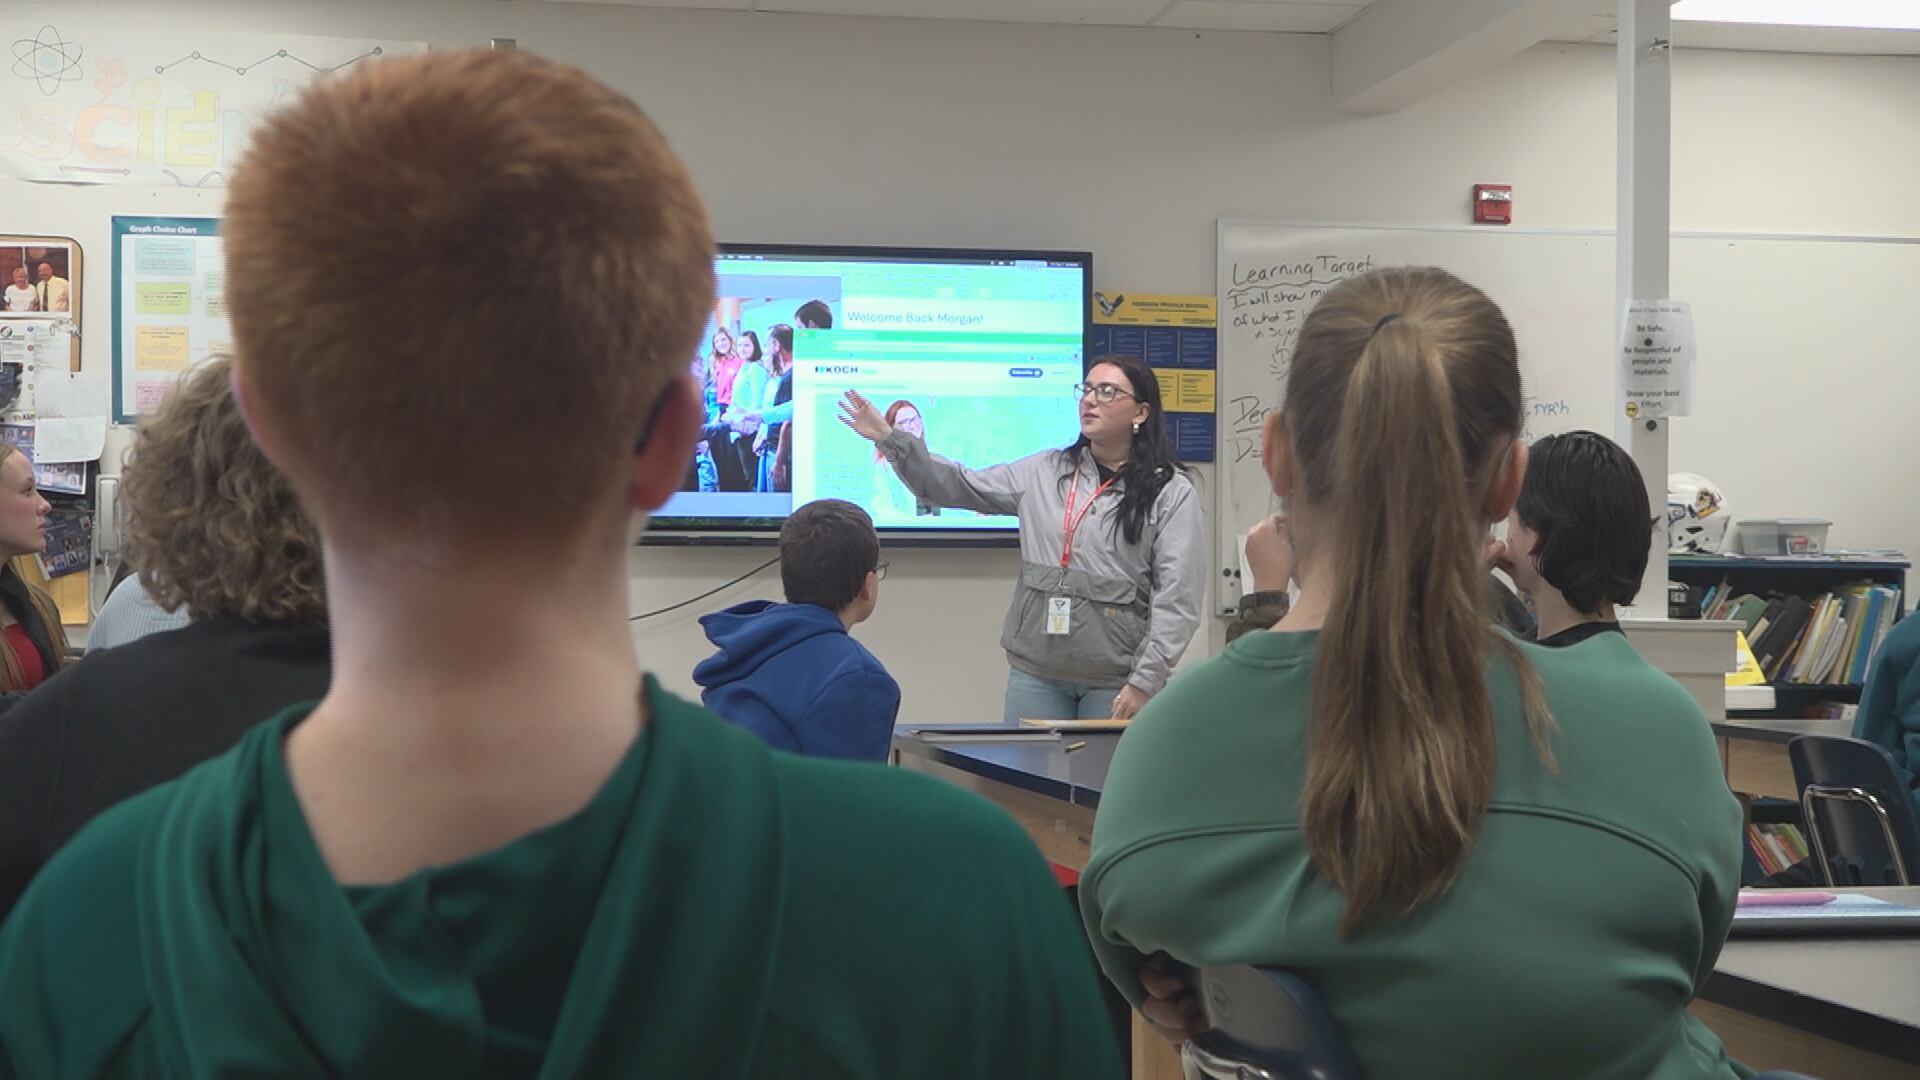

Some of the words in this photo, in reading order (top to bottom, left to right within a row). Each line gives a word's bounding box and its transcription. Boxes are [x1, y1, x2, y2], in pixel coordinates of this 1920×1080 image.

[129, 225, 152, 233] Graph
[152, 225, 176, 233] Choice
[177, 226, 197, 234] Chart
[1232, 263, 1313, 287] Learning
[1315, 254, 1371, 276] Target
[1228, 293, 1248, 310] I
[1250, 291, 1269, 305] will
[1274, 291, 1306, 302] show
[848, 311, 902, 324] Welcome
[906, 312, 934, 325] Back
[937, 313, 983, 327] Morgan!
[1233, 312, 1248, 327] of
[1251, 311, 1280, 325] what
[1283, 309, 1295, 321] I
[1637, 324, 1646, 332] Be
[1624, 345, 1633, 353] Be
[1634, 345, 1671, 354] Respectful
[1673, 345, 1681, 353] of
[1632, 357, 1656, 365] people
[826, 365, 859, 375] KOCH
[1627, 389, 1644, 397] Show
[1664, 389, 1680, 397] best
